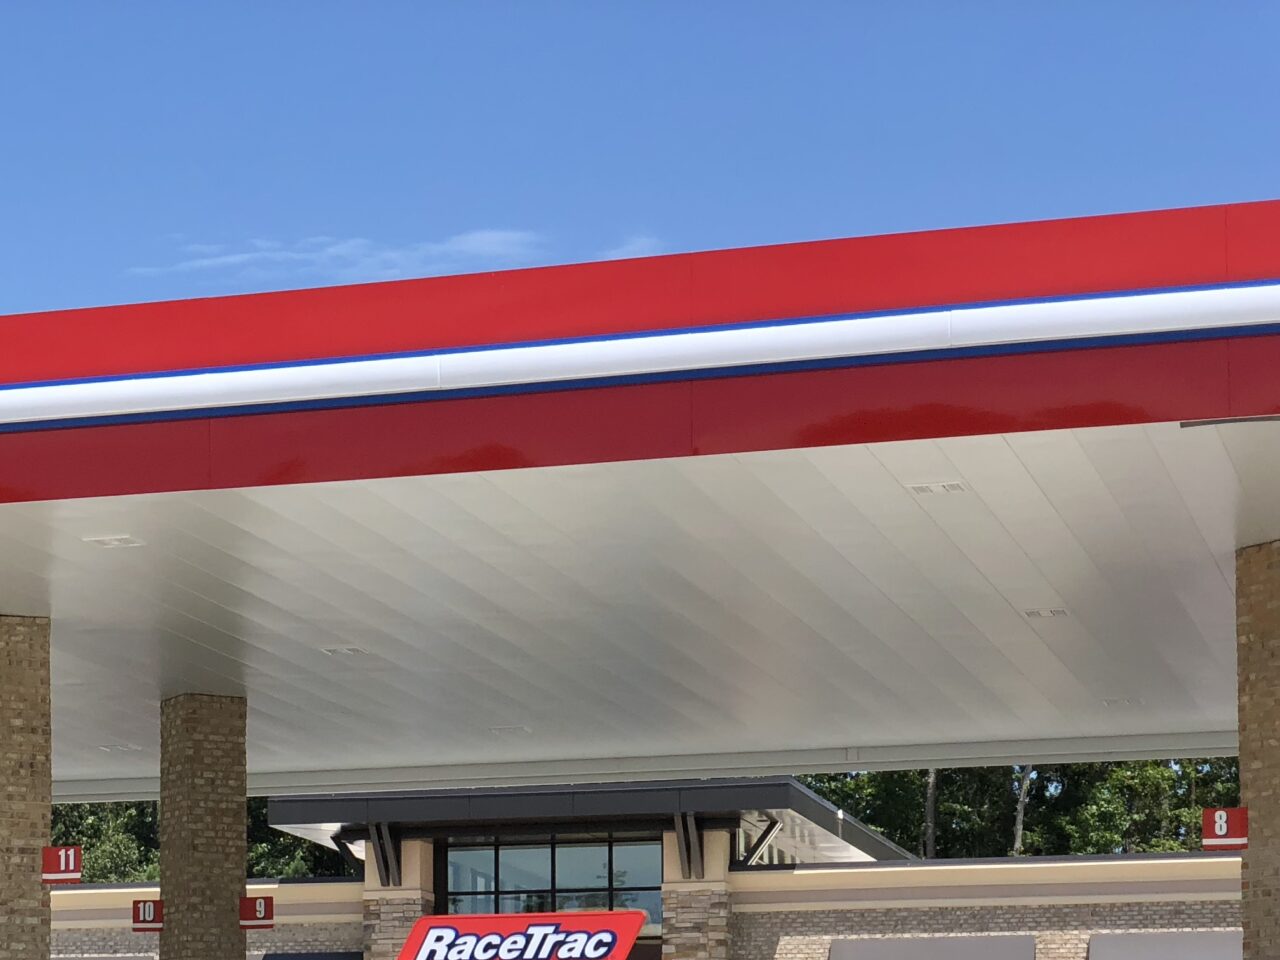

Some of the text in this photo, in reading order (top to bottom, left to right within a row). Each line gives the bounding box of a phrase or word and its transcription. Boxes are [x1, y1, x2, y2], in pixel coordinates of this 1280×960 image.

[1214, 811, 1228, 836] 8
[58, 848, 76, 871] 11
[137, 901, 155, 922] 10
[255, 898, 266, 919] 9
